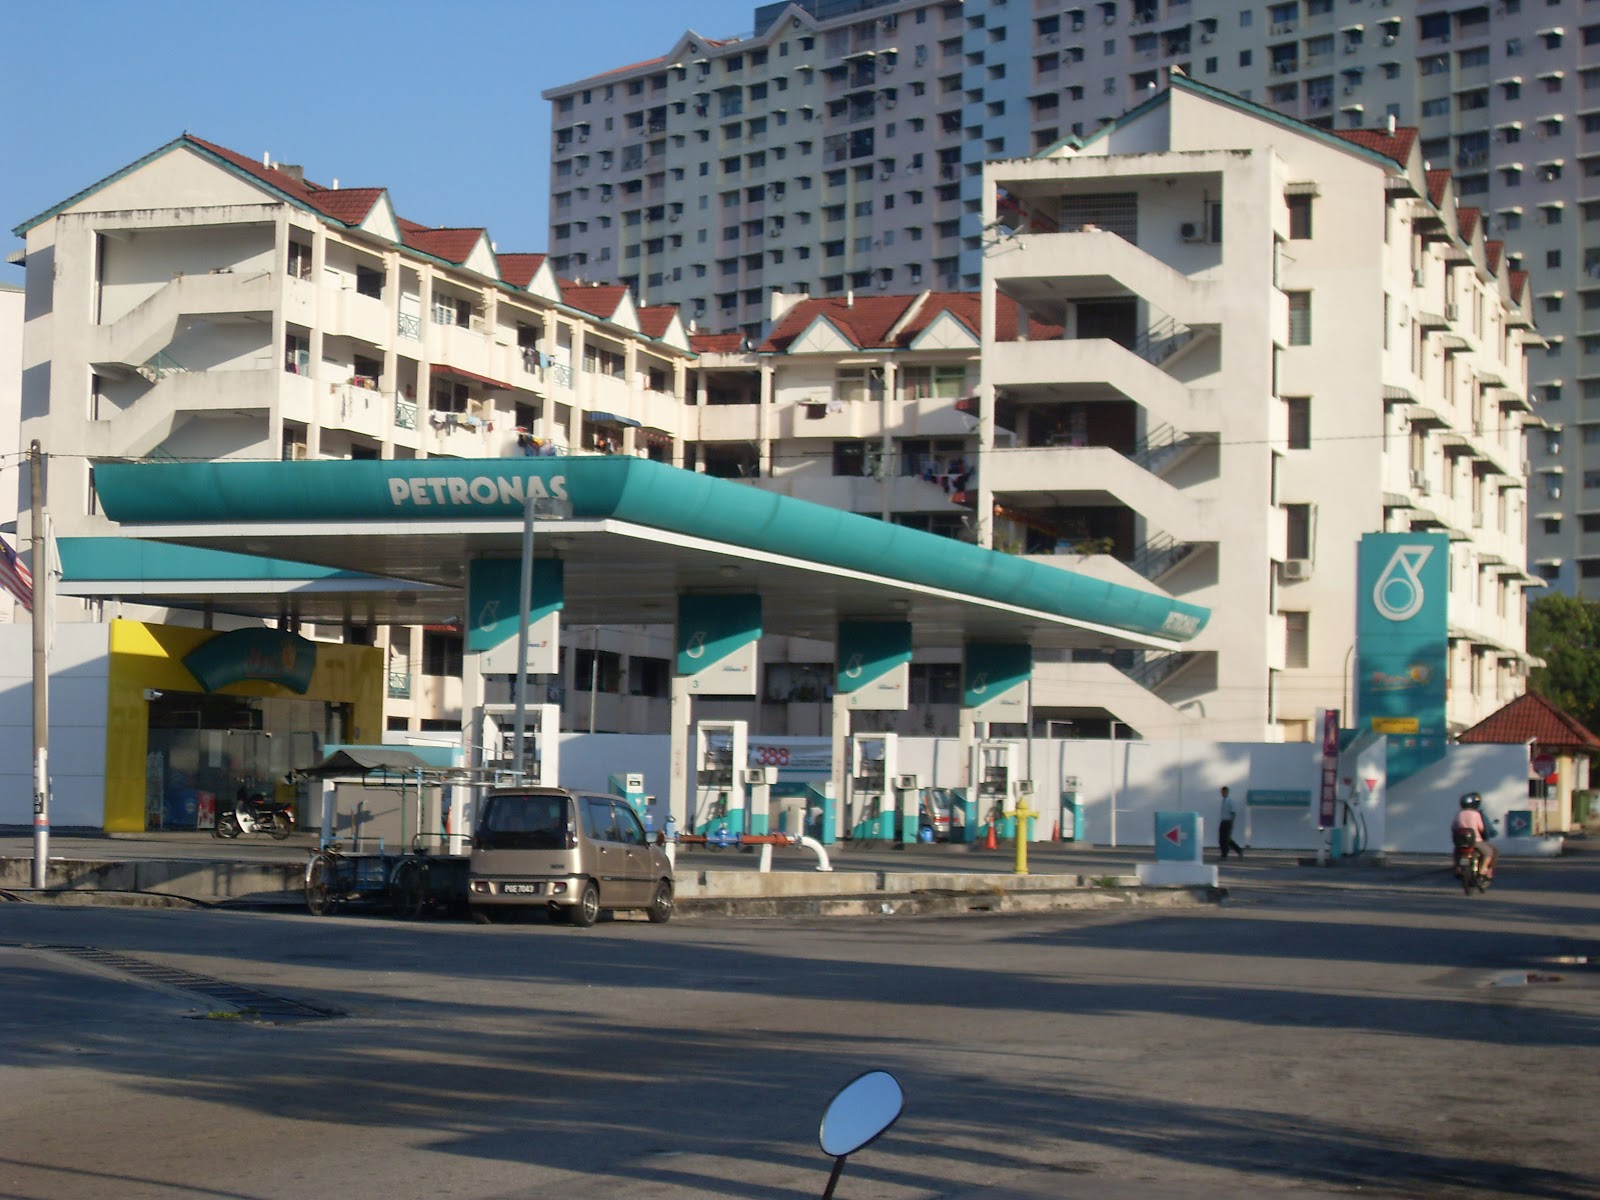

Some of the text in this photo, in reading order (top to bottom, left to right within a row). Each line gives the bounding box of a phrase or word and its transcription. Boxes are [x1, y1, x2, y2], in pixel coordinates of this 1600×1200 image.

[388, 475, 568, 506] PETRONAS
[692, 680, 699, 689] 3
[756, 746, 790, 766] 388
